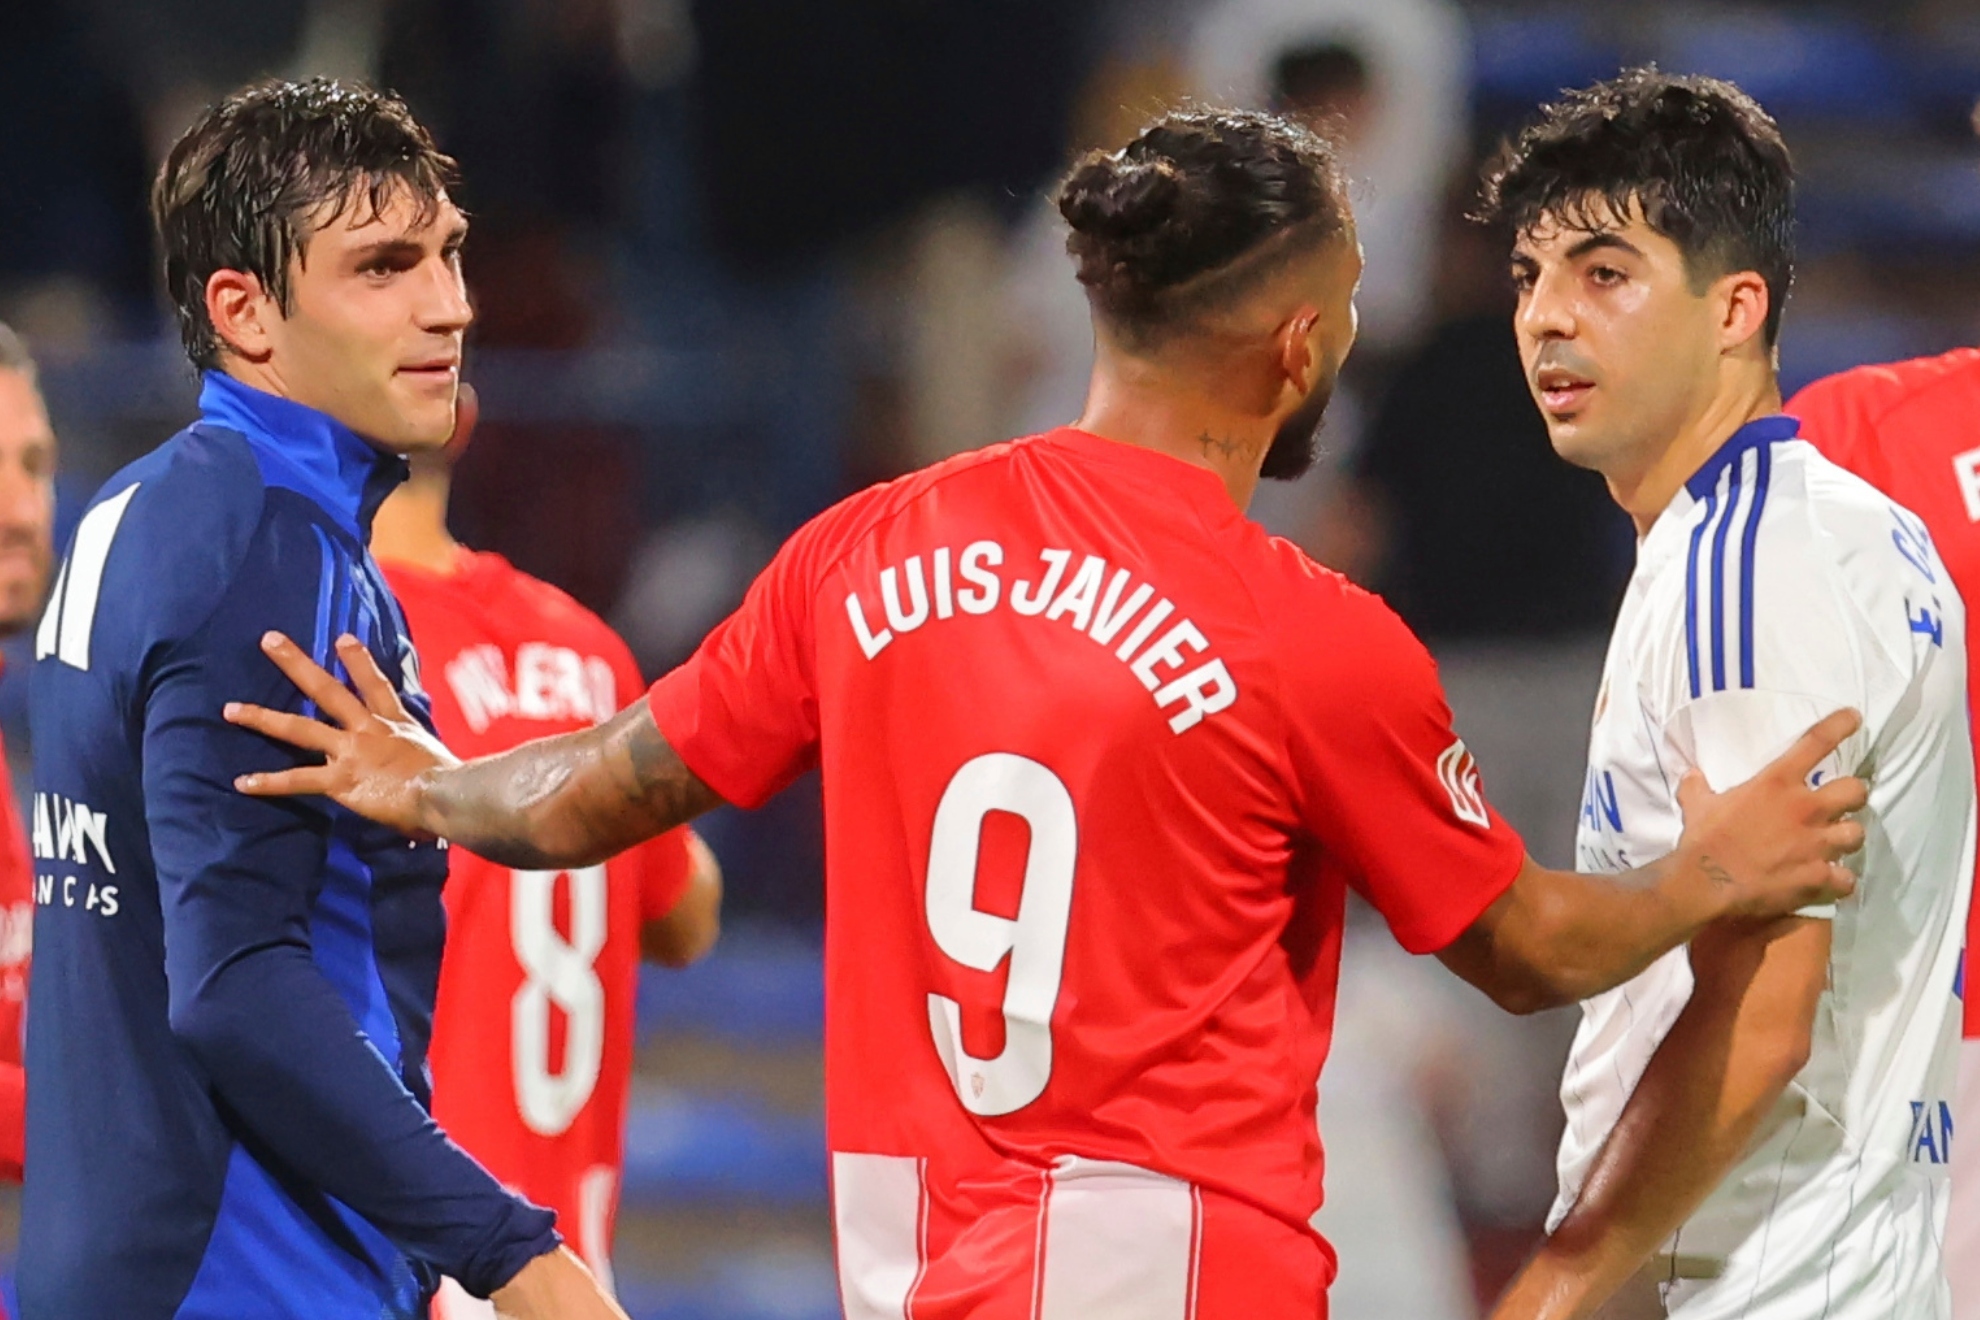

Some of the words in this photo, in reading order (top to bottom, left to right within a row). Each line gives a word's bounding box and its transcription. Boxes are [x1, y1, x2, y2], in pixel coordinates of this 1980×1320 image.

[845, 540, 1004, 660] LUIS
[1009, 548, 1238, 735] JAVIER
[510, 866, 608, 1137] 8
[925, 752, 1079, 1117] 9
